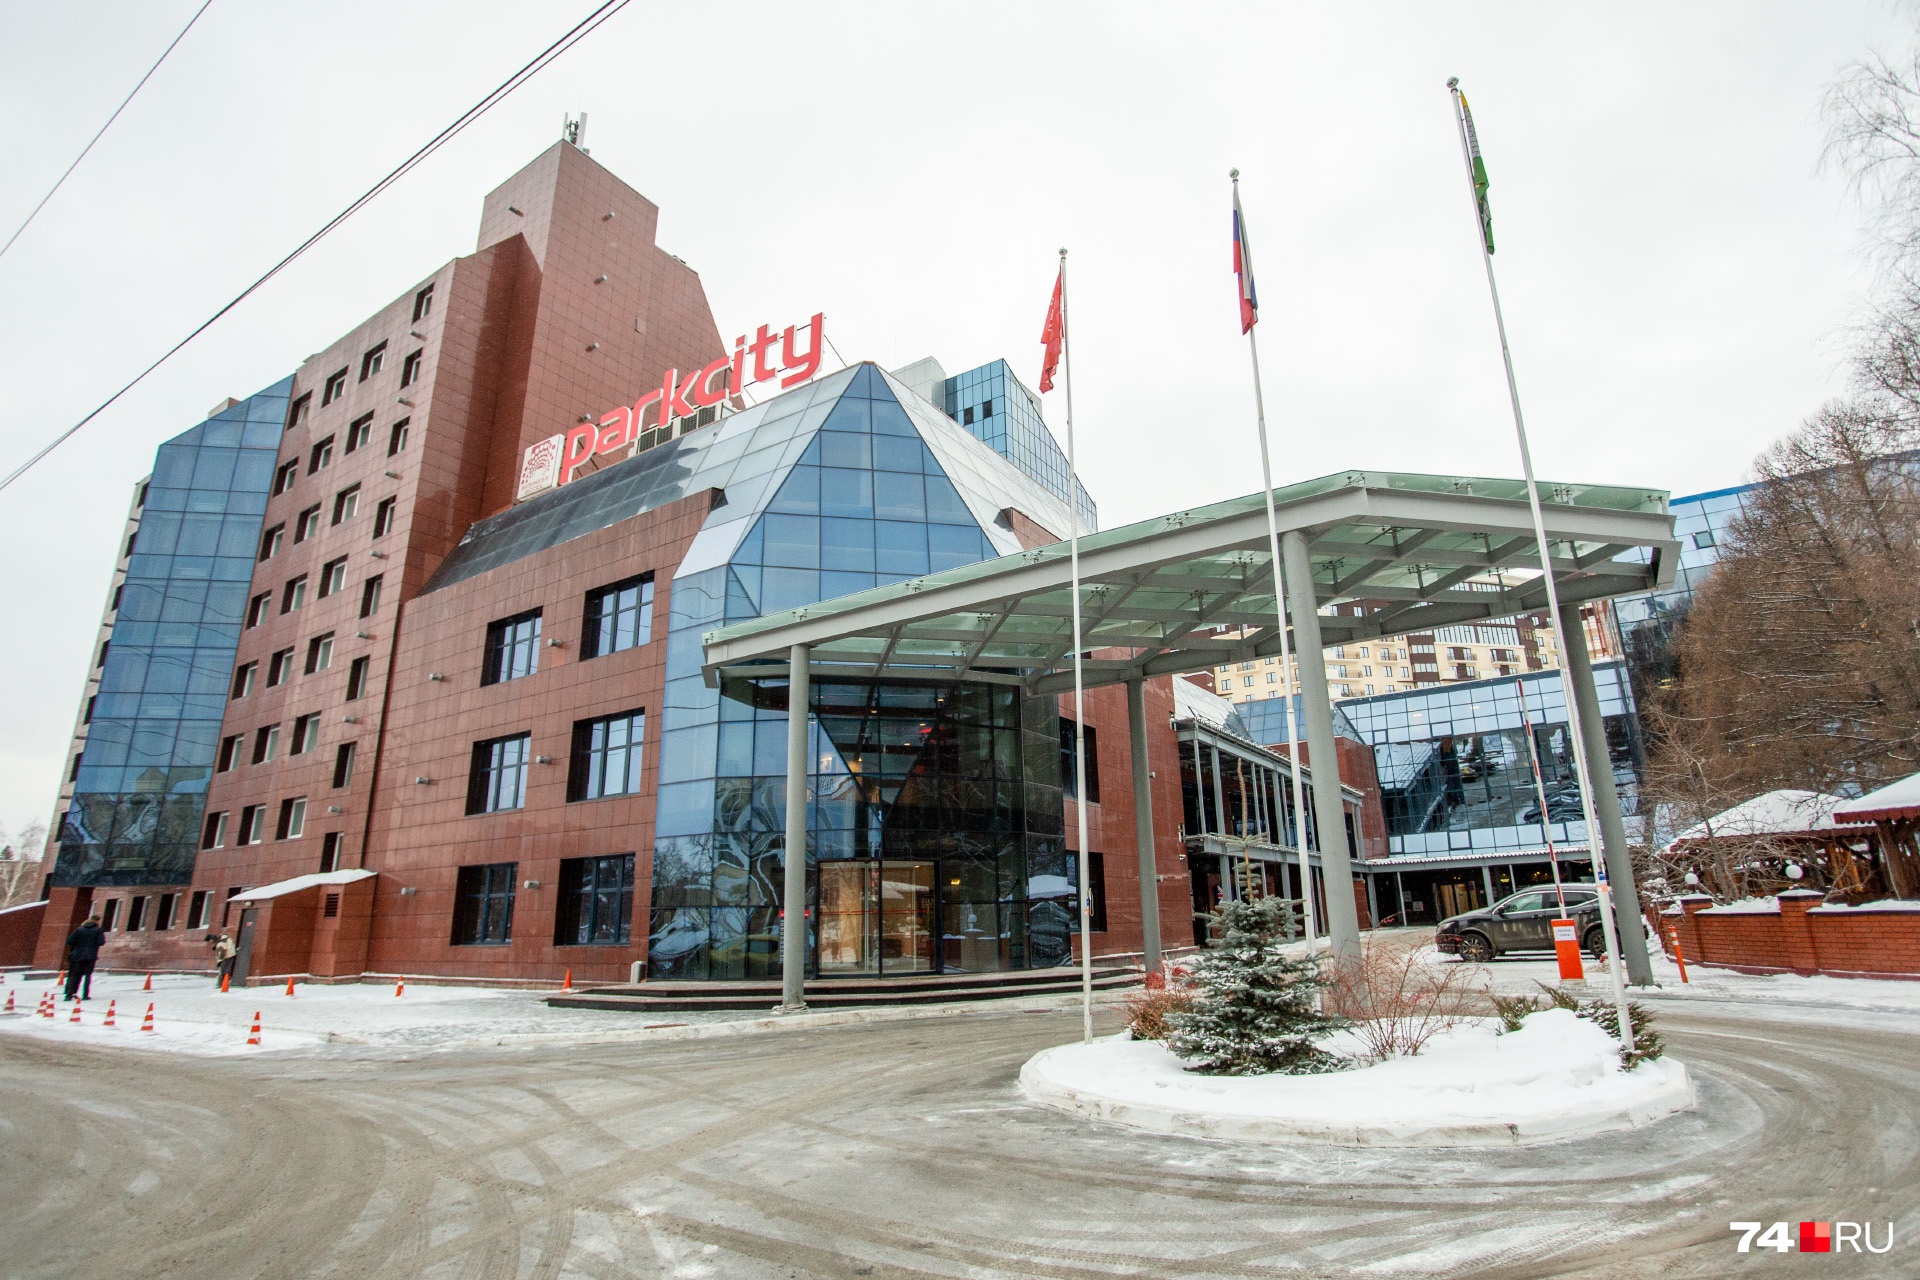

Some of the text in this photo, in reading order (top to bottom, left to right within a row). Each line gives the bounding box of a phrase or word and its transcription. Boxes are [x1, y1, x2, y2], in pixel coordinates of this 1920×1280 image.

[559, 312, 824, 485] parkcity
[521, 476, 549, 491] BUSINESS
[525, 484, 543, 495] HOTEL
